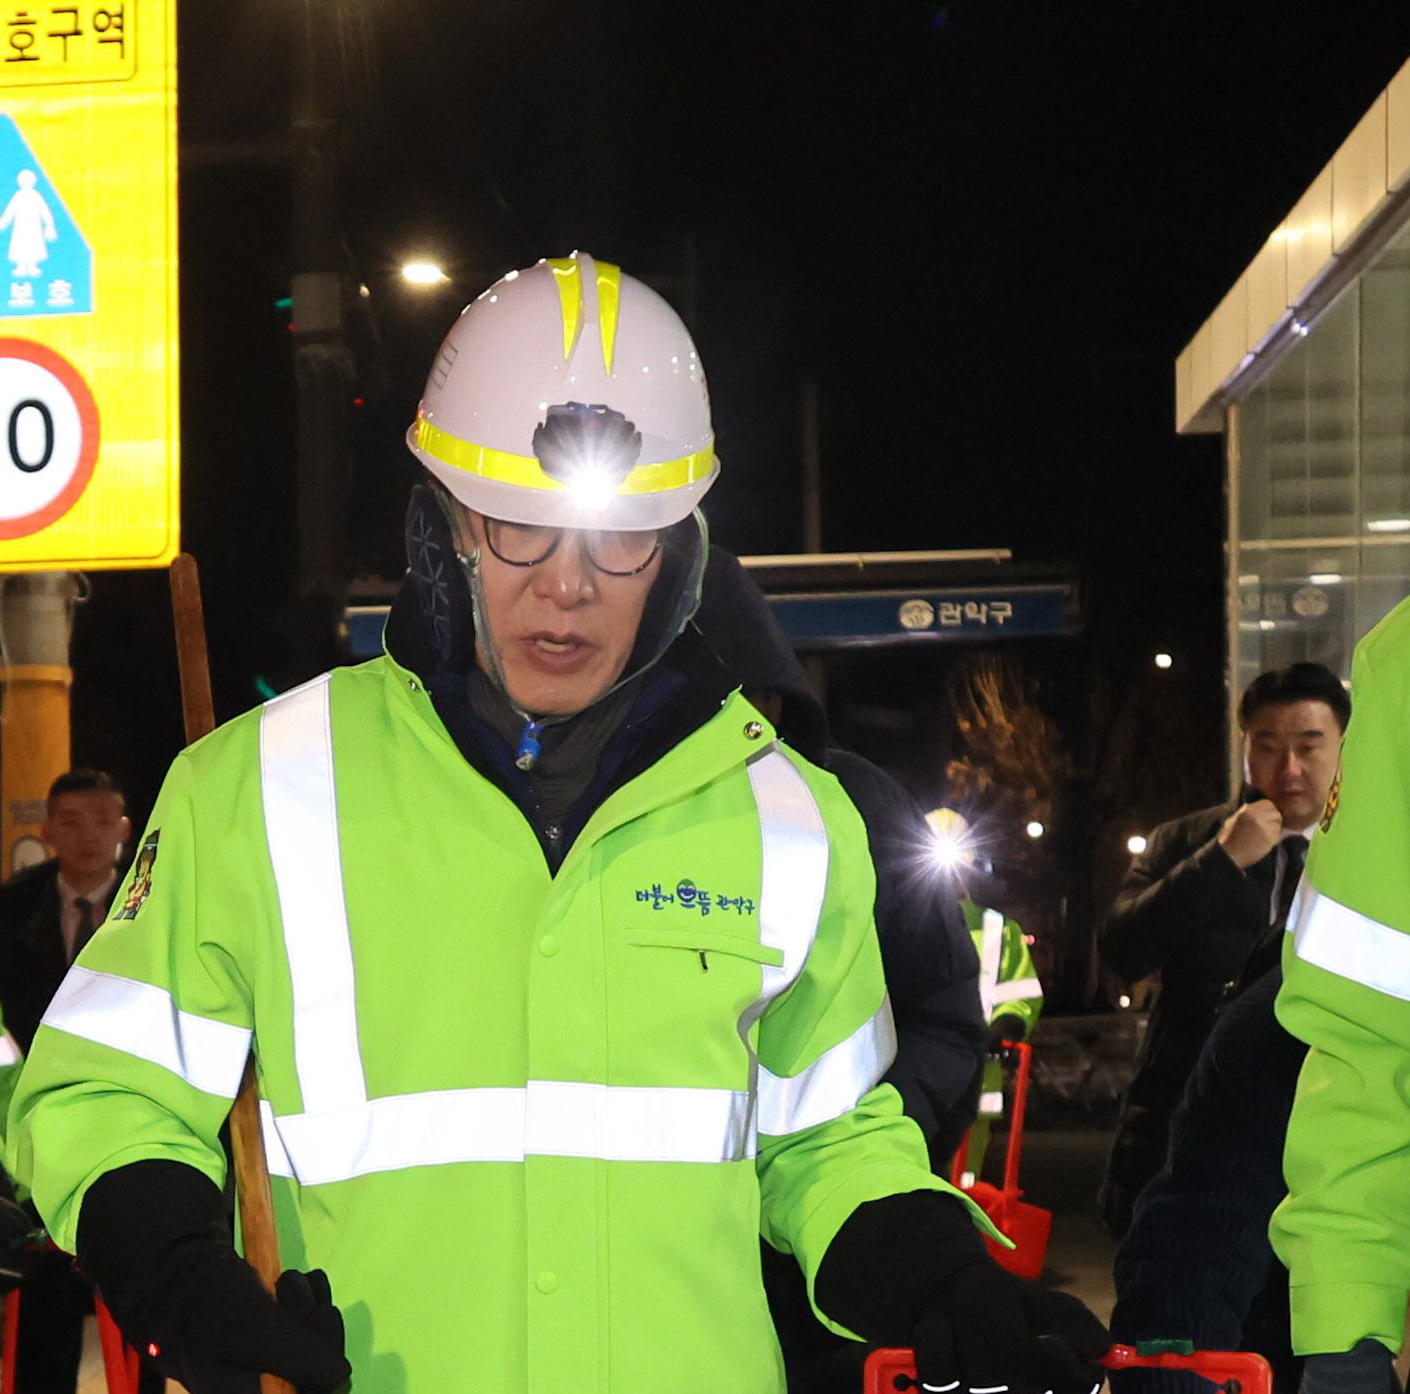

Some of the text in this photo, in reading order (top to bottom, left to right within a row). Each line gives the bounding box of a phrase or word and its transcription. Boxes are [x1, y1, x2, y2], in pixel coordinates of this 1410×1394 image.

[938, 600, 1012, 625] 관악구
[635, 883, 675, 911] 더불어
[716, 894, 756, 916] 관악구
